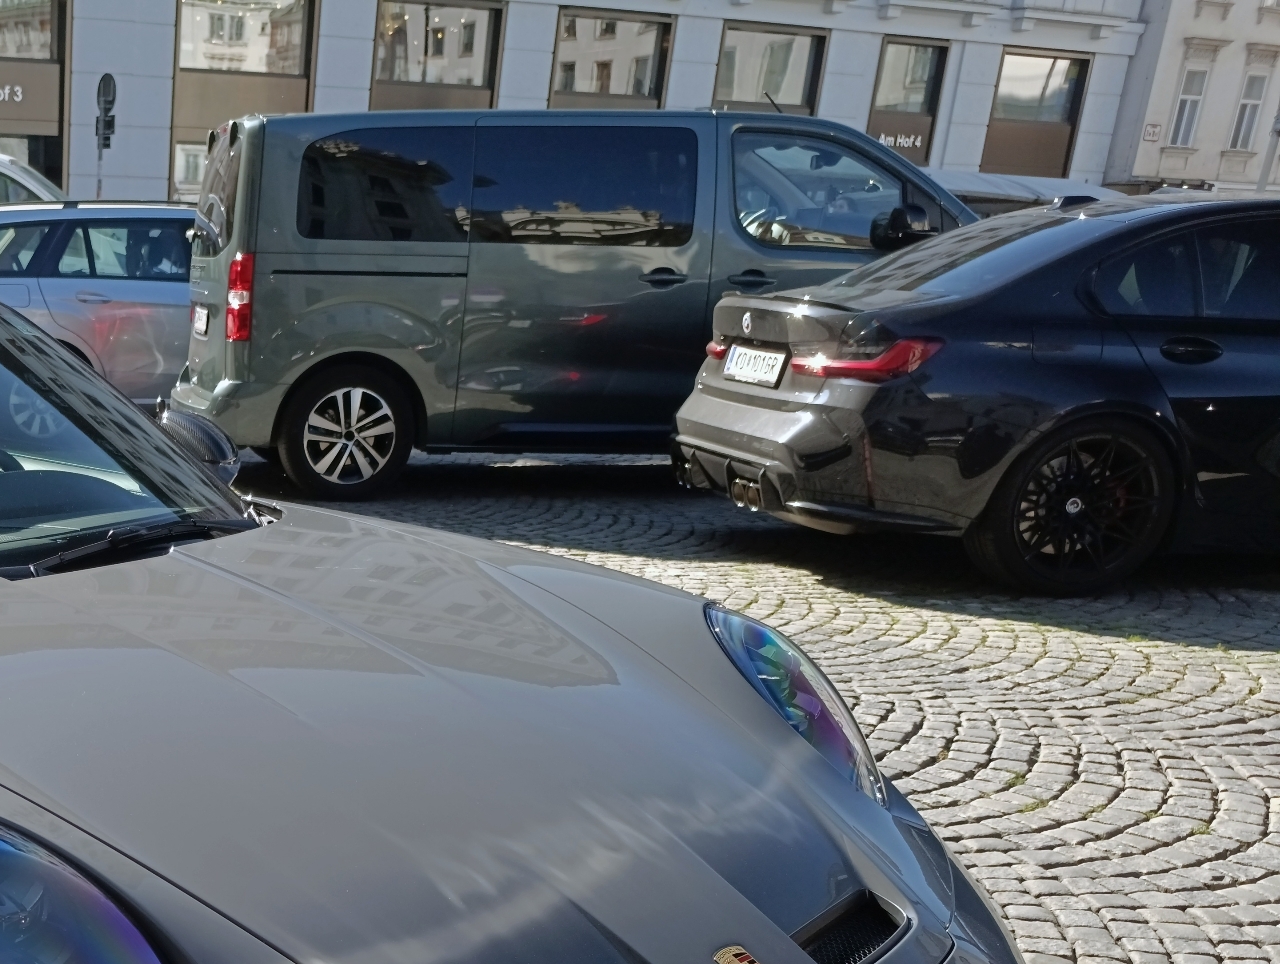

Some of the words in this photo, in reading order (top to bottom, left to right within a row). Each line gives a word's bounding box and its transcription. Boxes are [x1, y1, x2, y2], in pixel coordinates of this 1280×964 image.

[13, 85, 23, 102] 3
[879, 132, 894, 146] Am
[896, 133, 915, 148] Hof
[915, 134, 922, 148] 4
